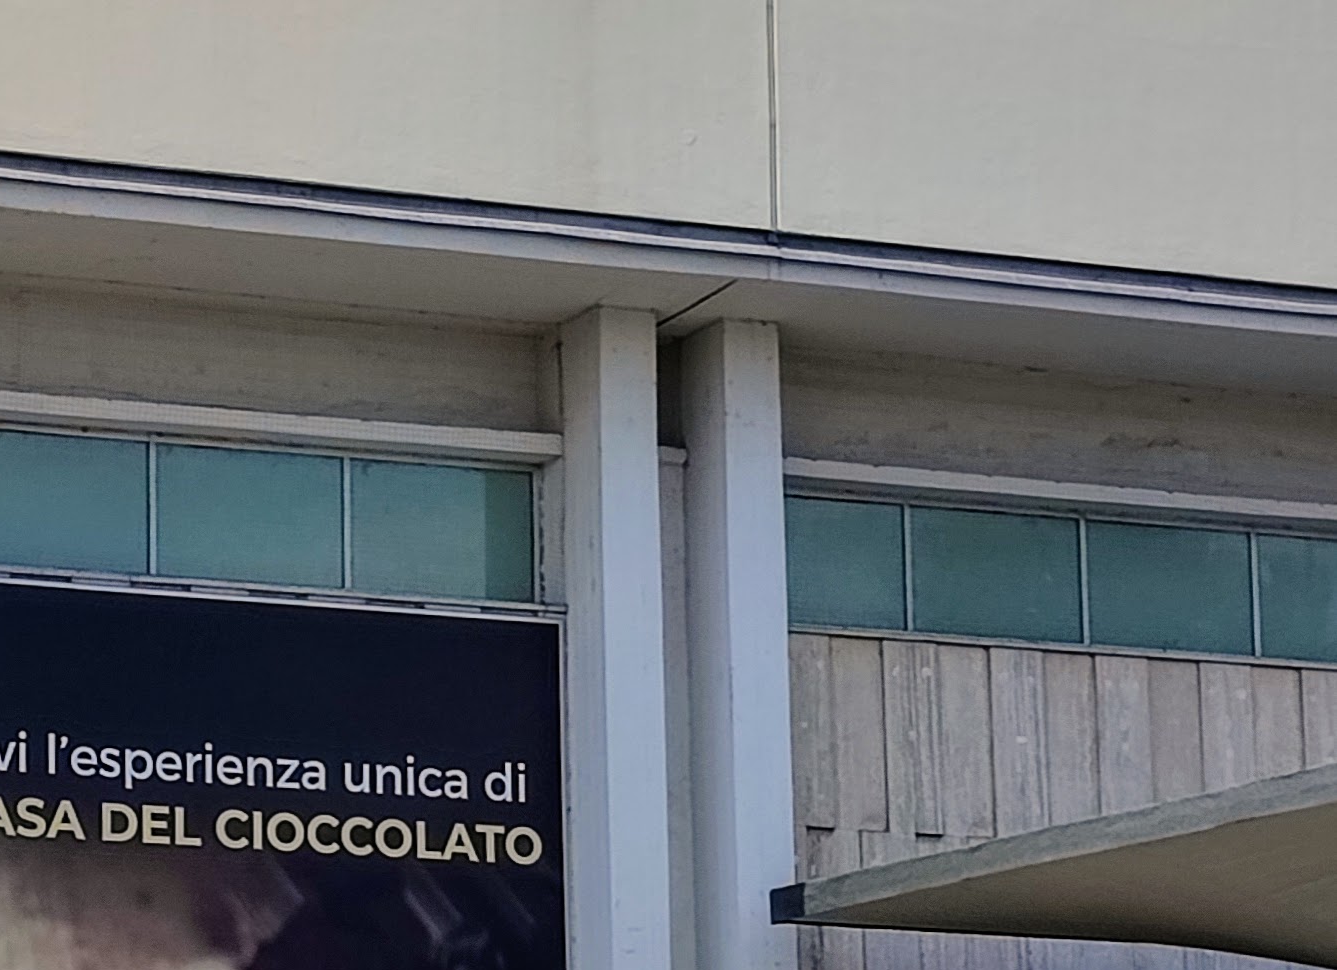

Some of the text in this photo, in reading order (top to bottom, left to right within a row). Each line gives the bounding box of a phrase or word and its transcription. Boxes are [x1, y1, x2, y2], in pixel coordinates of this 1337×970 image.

[344, 755, 468, 800] unica
[484, 761, 526, 803] di
[101, 802, 202, 847] DEL
[215, 809, 543, 865] CIOCCOLATO
